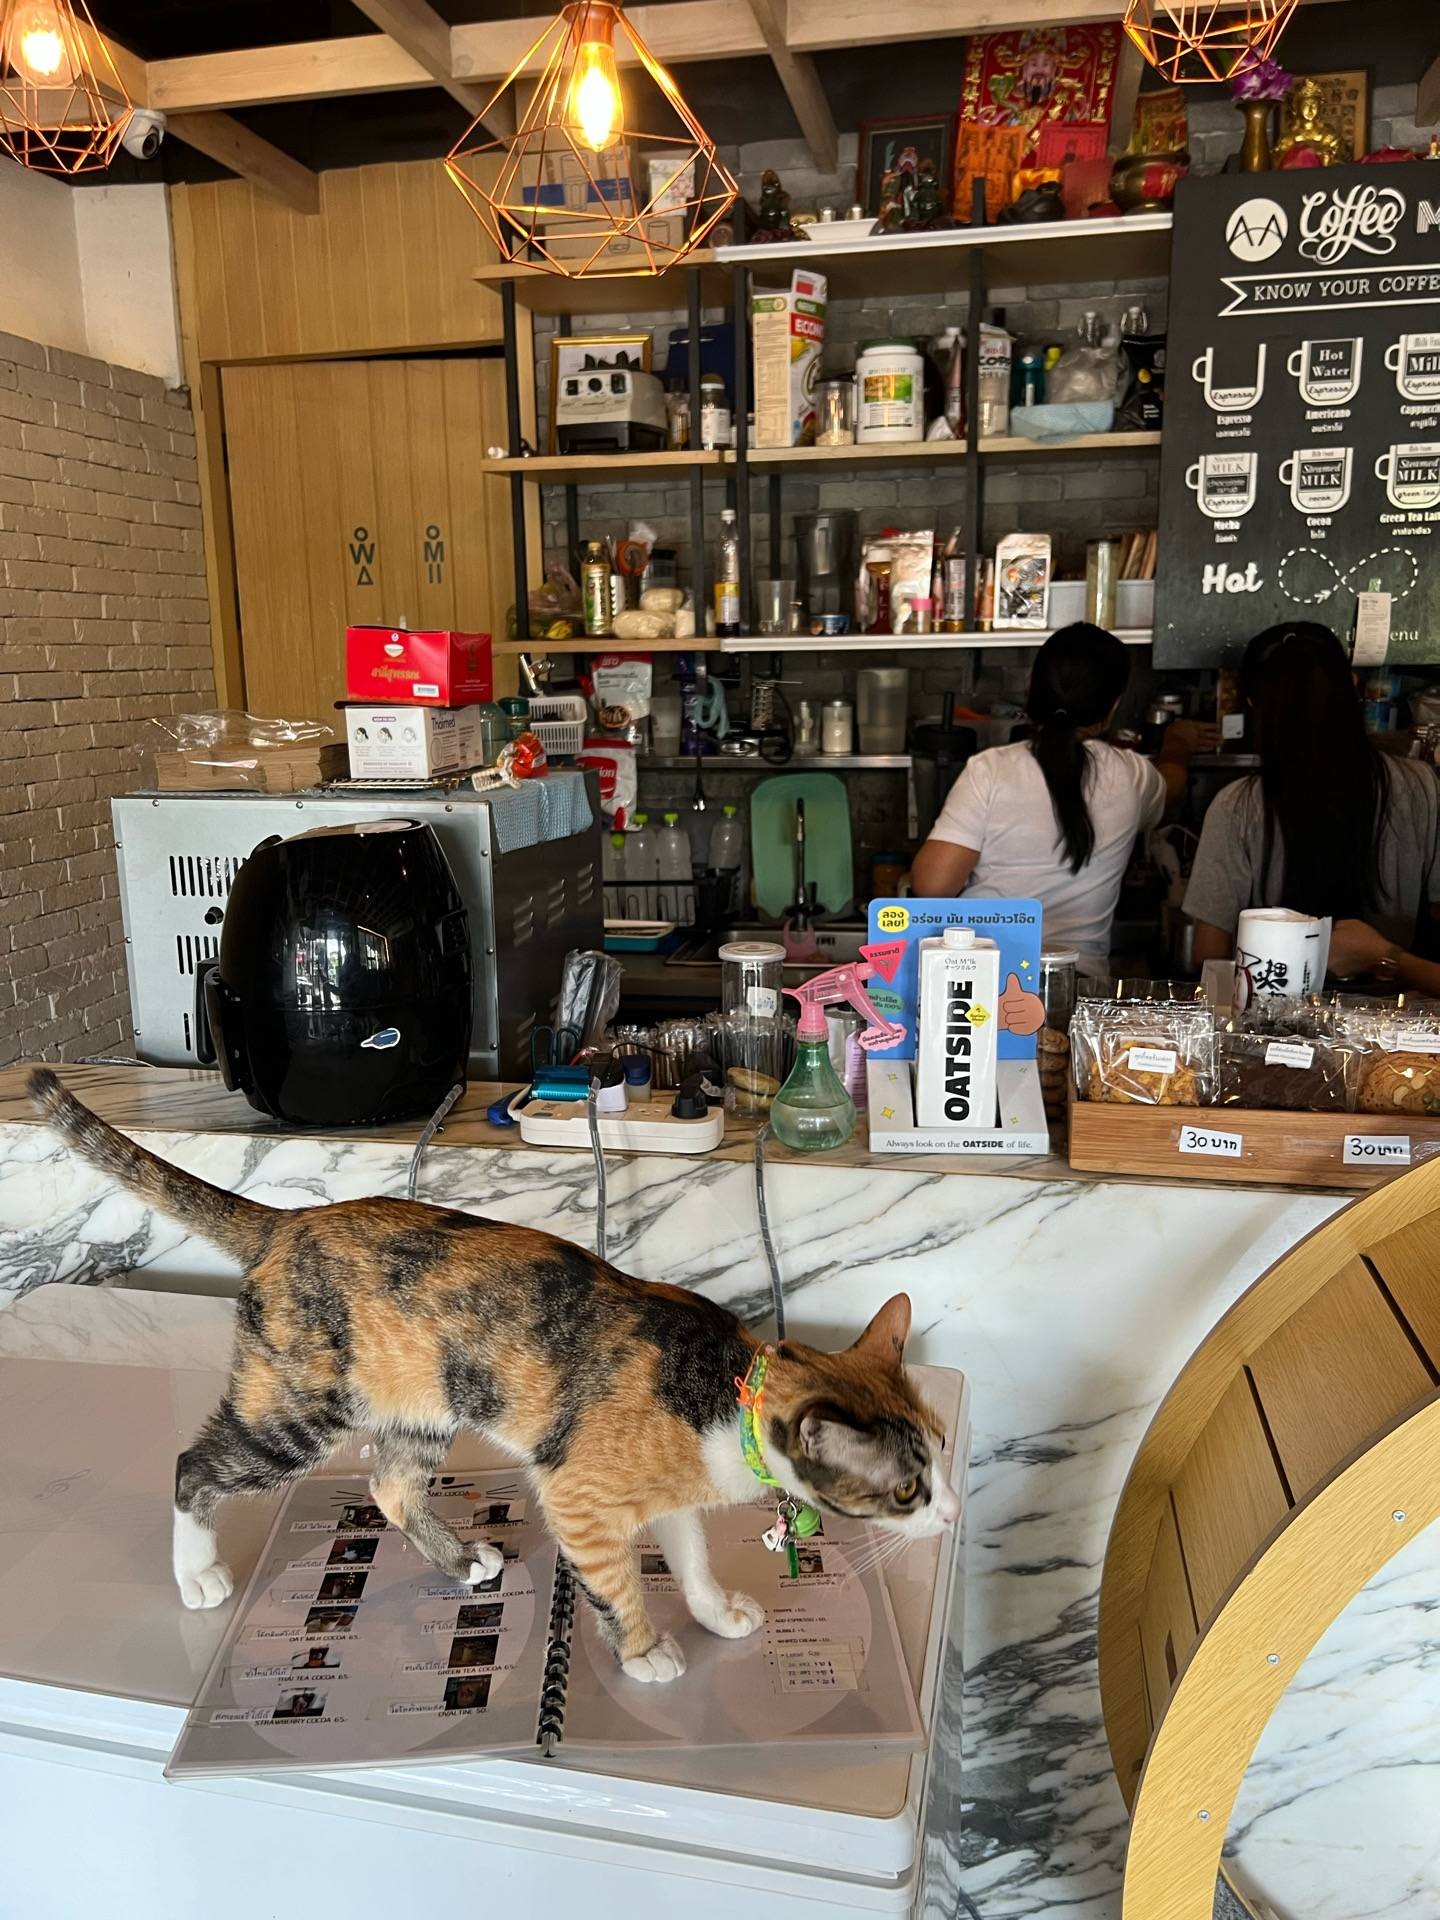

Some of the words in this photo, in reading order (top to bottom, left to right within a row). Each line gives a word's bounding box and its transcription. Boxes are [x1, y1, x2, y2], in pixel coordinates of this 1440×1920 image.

[1299, 184, 1406, 265] Coffee
[1254, 283, 1311, 301] KNOW
[1319, 279, 1370, 297] YOUR
[1320, 350, 1343, 362] Hot
[1312, 365, 1349, 377] Water
[1305, 408, 1351, 420] Americano
[1217, 415, 1252, 426] Espresso
[1212, 464, 1244, 472] MILK
[1302, 462, 1342, 474] Steamed
[1399, 457, 1439, 468] Steamed
[1301, 474, 1340, 486] MILK
[1398, 469, 1437, 481] MILK
[1307, 517, 1332, 527] Cocoa
[1380, 513, 1406, 524] Green
[1408, 512, 1423, 522] Tea
[1214, 520, 1240, 530] Mocha
[1202, 562, 1264, 595] Hot
[1390, 630, 1418, 641] enu
[882, 911, 905, 919] ลอง
[911, 913, 942, 924] อร่อย
[882, 918, 905, 928] เลย!
[944, 980, 973, 1121] OATSIDE
[886, 1140, 914, 1149] Always
[916, 1139, 933, 1148] look
[947, 1140, 960, 1148] the
[963, 1140, 1003, 1148] OATSIDE
[1006, 1140, 1015, 1148] of
[1018, 1140, 1033, 1148] life.
[1186, 1131, 1208, 1148] 30
[1211, 1139, 1237, 1150] บาท
[1351, 1138, 1375, 1156] 30
